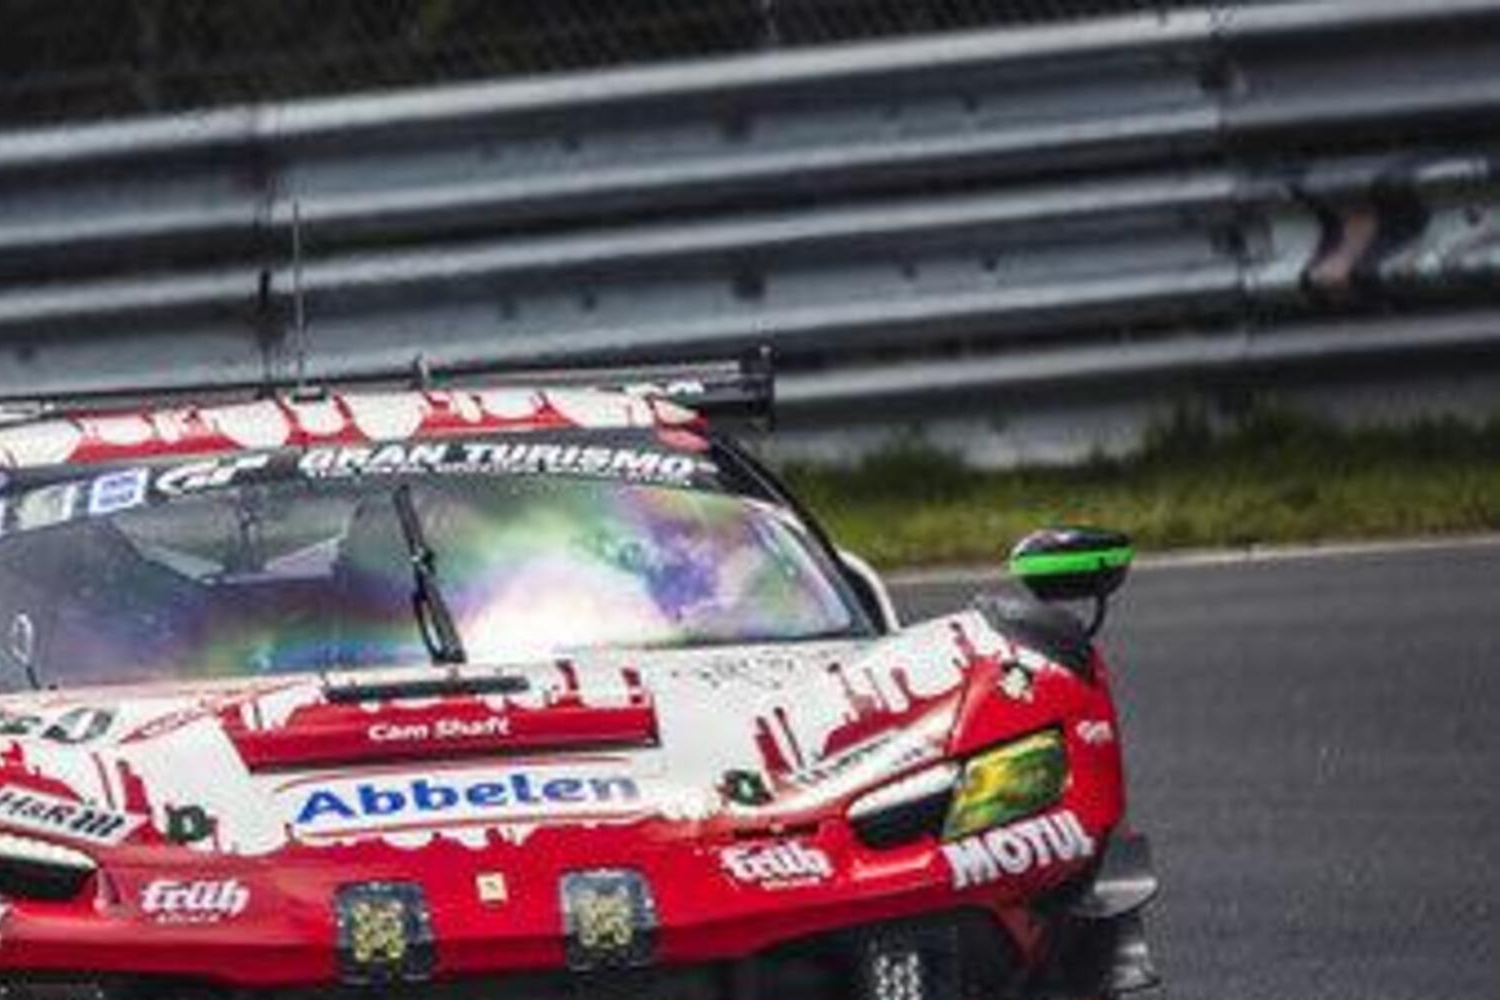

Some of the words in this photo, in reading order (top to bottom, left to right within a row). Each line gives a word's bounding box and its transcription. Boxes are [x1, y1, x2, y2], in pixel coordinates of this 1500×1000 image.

[298, 444, 450, 476] GRAN
[462, 442, 696, 478] TURISMO
[368, 723, 429, 742] Cam
[435, 715, 511, 739] Shaft
[297, 772, 641, 824] Abbelen
[940, 809, 1097, 892] MOTUL
